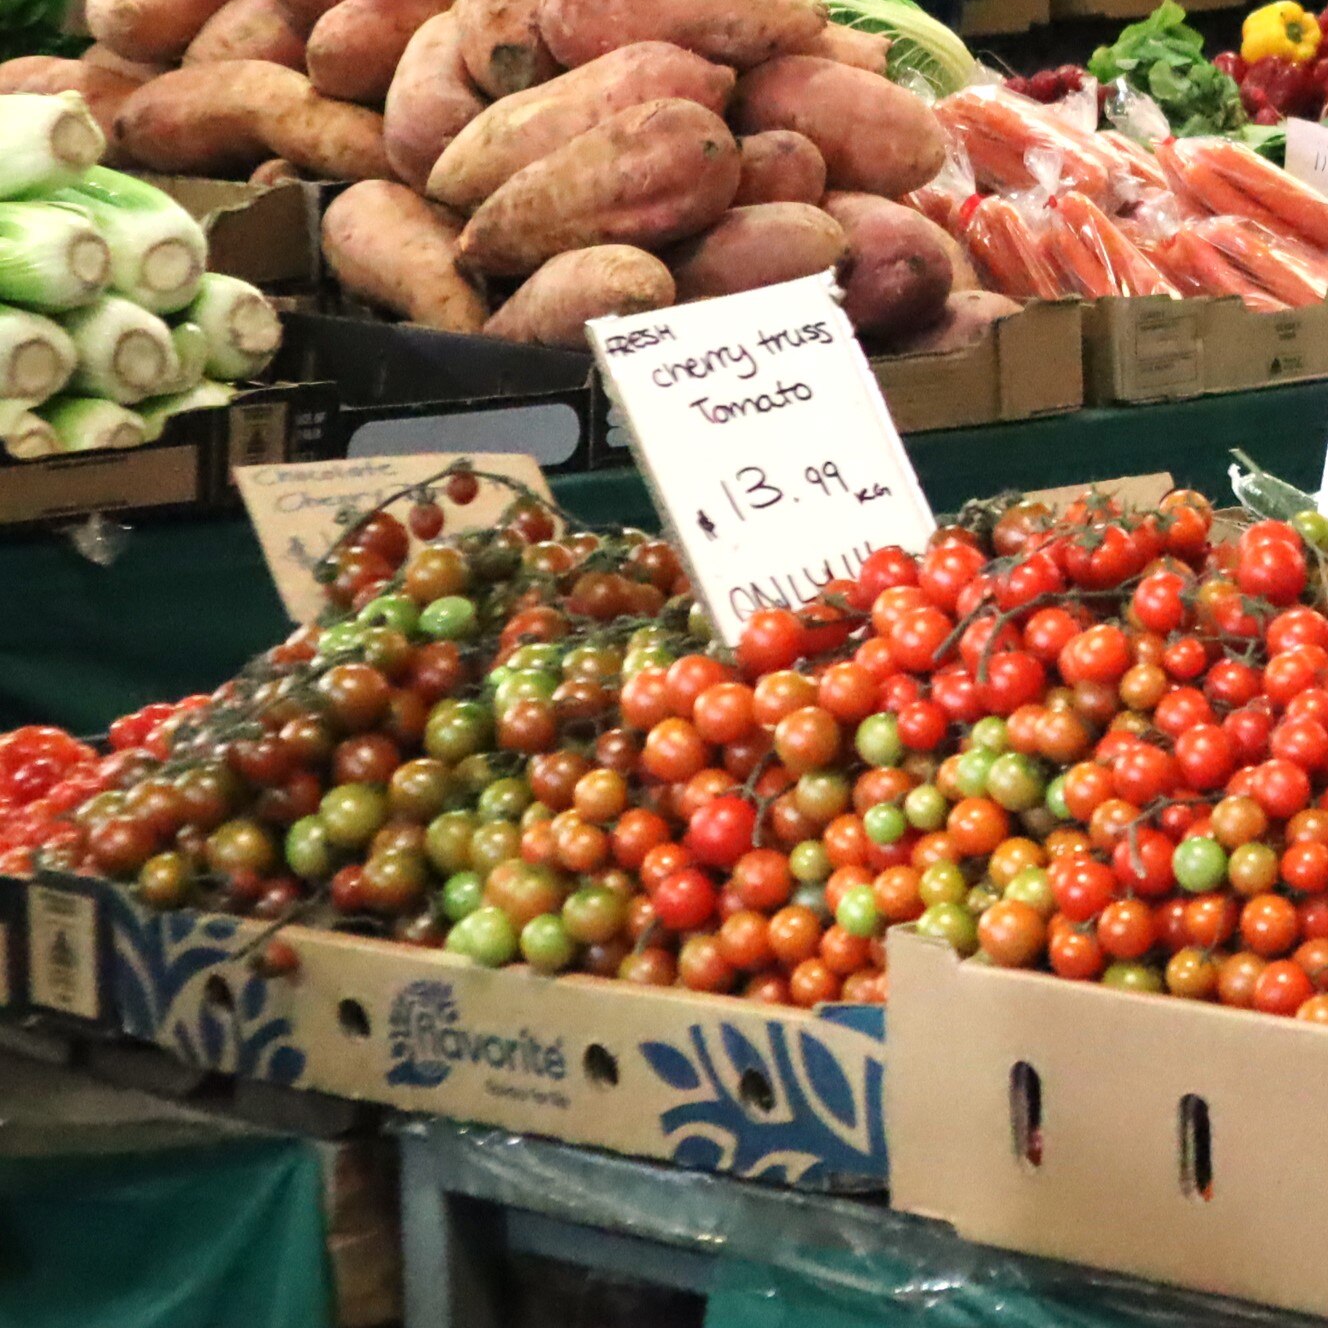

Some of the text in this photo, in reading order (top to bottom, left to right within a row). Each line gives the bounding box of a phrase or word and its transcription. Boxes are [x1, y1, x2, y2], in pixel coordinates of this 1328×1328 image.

[605, 324, 677, 358] FRESH
[757, 320, 835, 356] truss
[689, 380, 813, 424] Tomato
